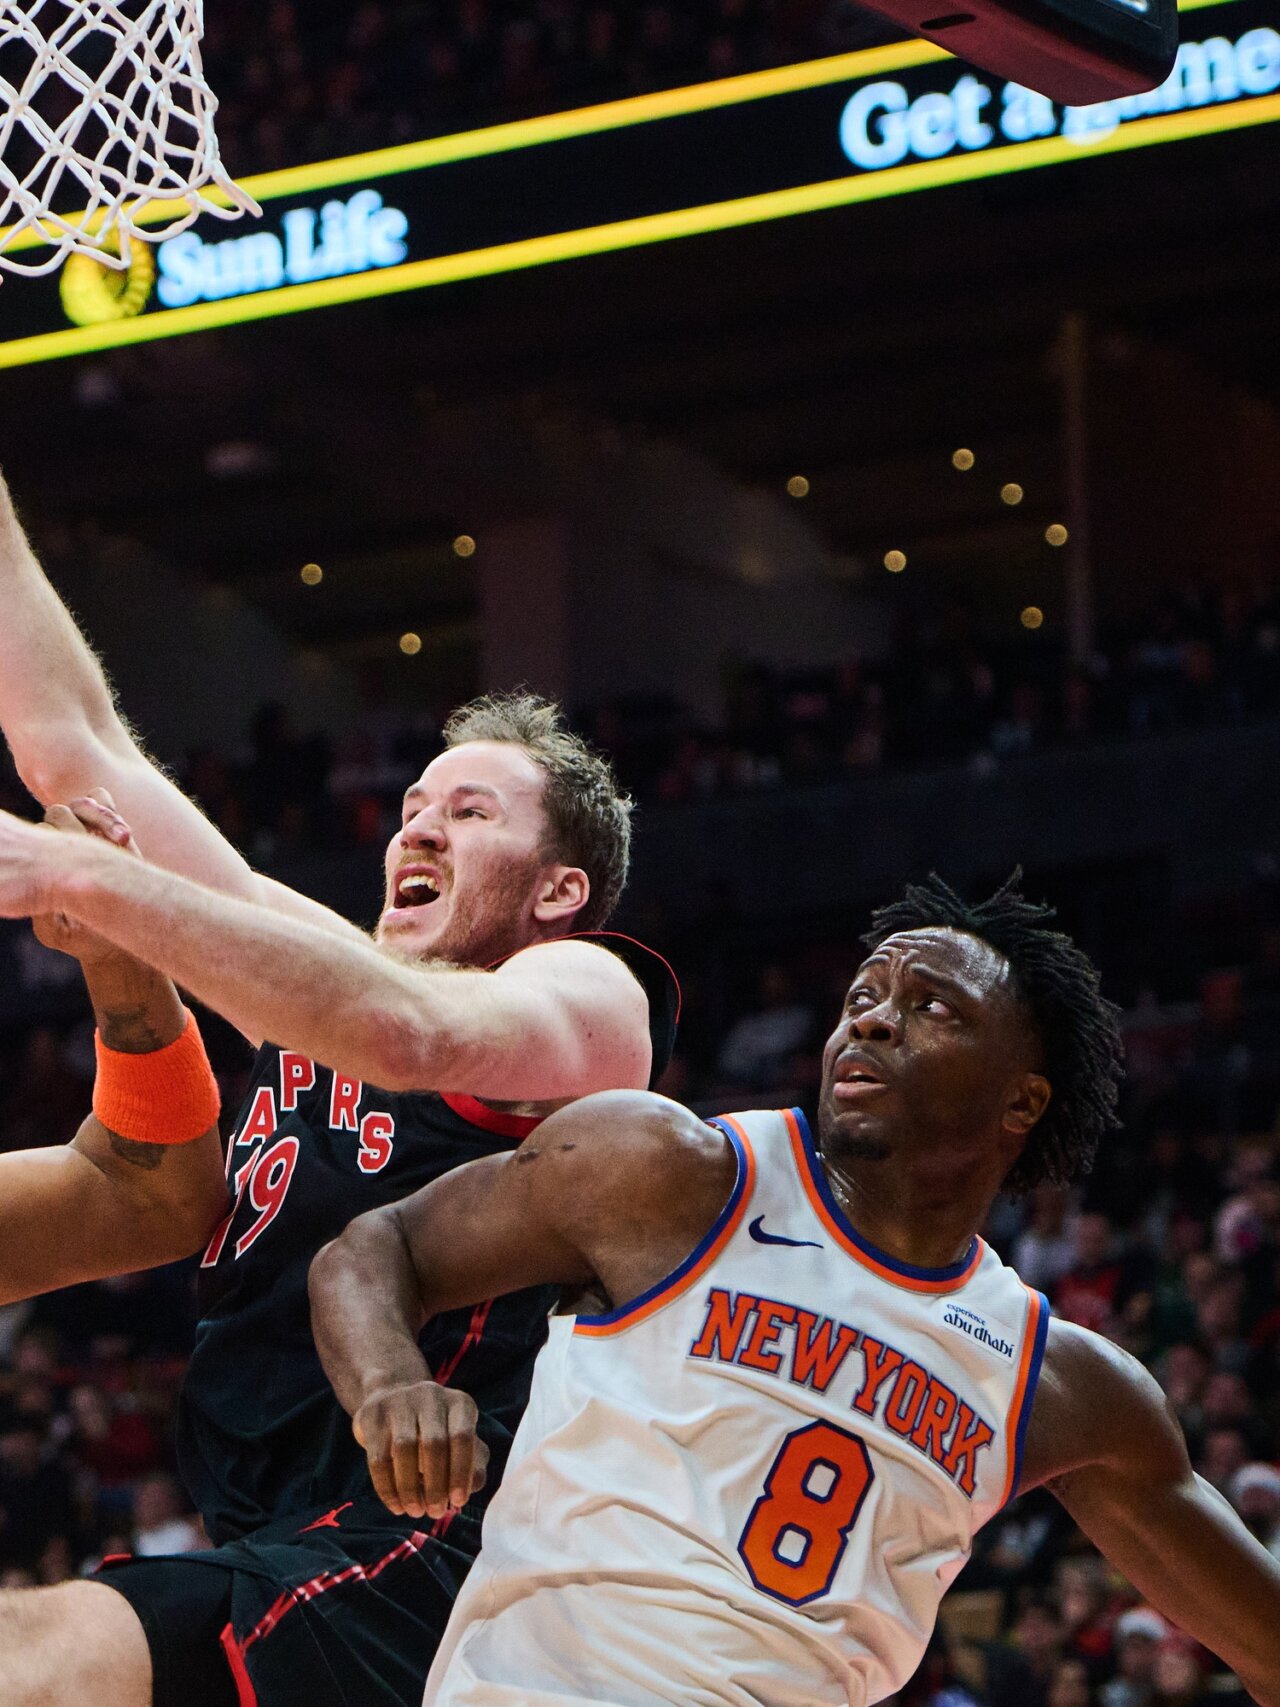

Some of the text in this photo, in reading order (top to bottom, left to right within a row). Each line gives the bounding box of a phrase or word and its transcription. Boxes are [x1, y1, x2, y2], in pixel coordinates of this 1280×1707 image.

[839, 73, 994, 170] Get
[1000, 81, 1057, 141] a
[157, 189, 408, 308] Sun Life
[200, 1136, 300, 1268] 19
[944, 1313, 1015, 1358] abu dhabi
[947, 1304, 986, 1325] experience
[690, 1286, 996, 1499] NEW YORK
[737, 1419, 875, 1608] 8
